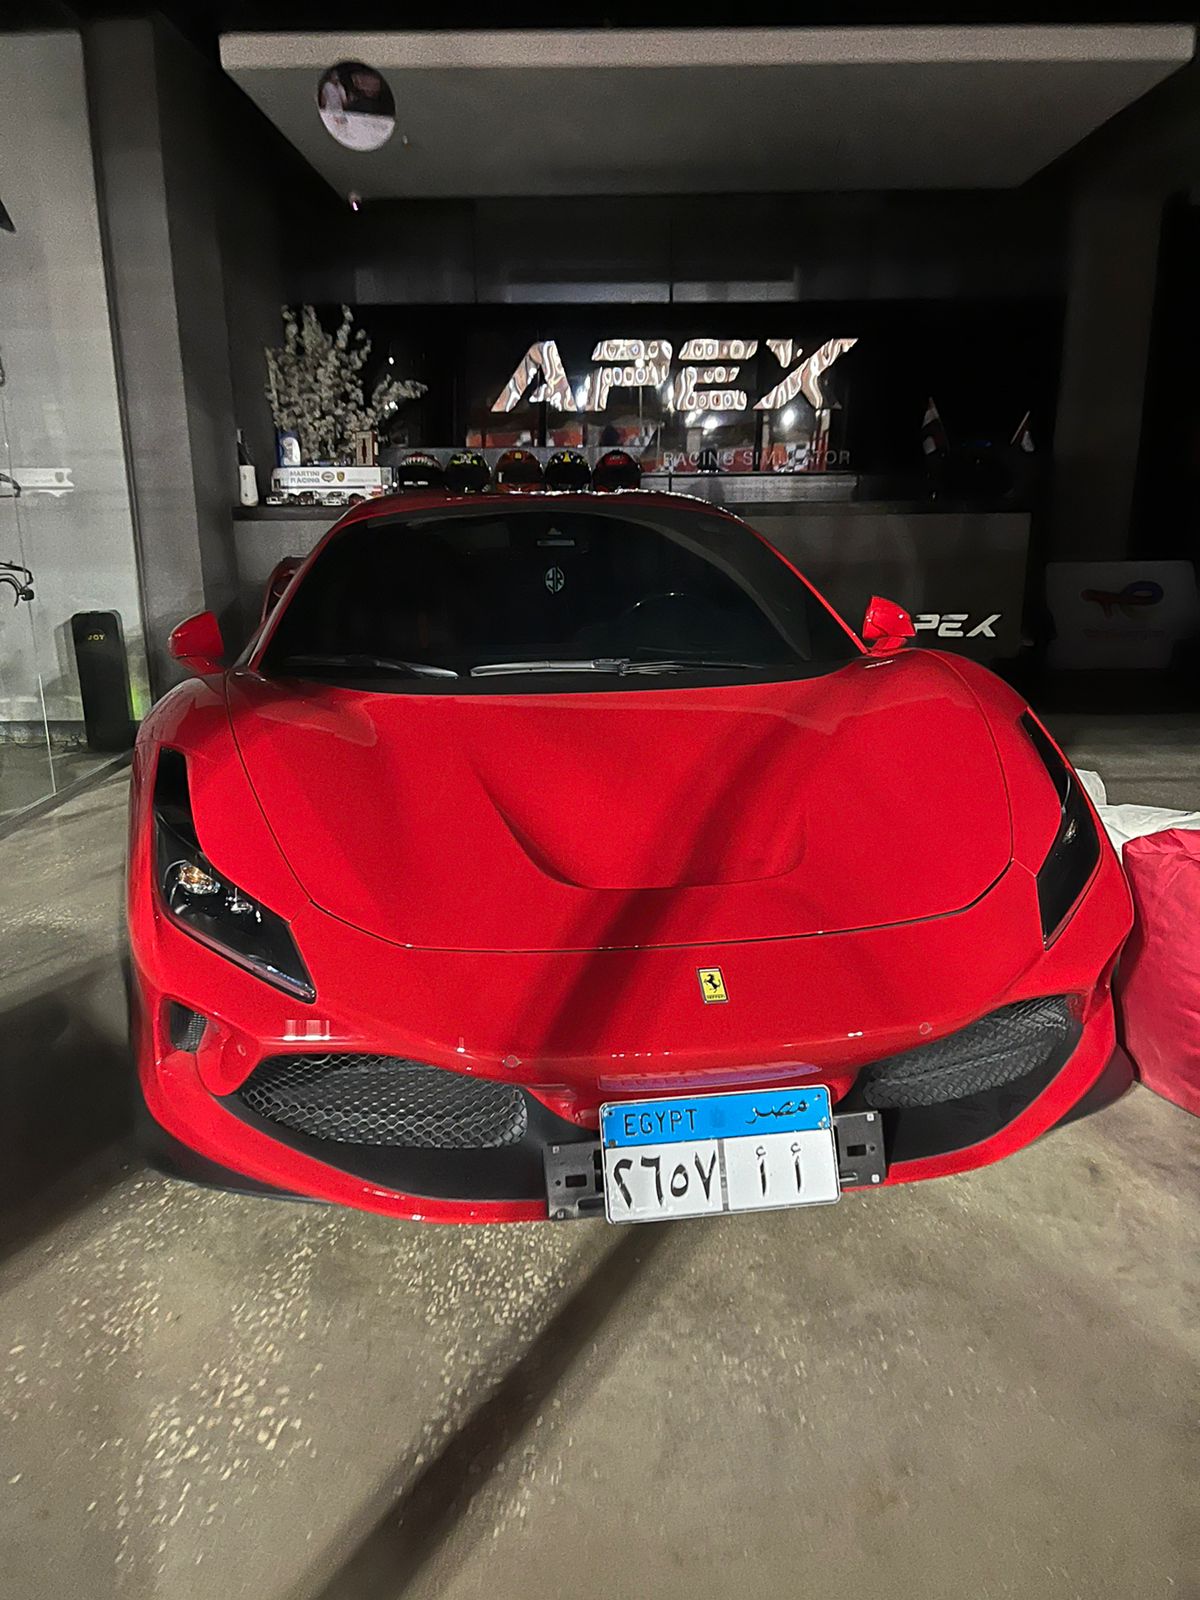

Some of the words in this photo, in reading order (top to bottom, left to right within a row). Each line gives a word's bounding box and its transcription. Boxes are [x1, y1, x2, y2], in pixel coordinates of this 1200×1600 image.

[491, 338, 859, 413] APEX
[663, 451, 735, 466] RACING
[743, 450, 850, 467] SIMUATOR
[913, 614, 1001, 637] PEX
[624, 1109, 698, 1136] EGYPT
[745, 1100, 808, 1124] مصر
[612, 1151, 716, 1209] ٢٦٥٧
